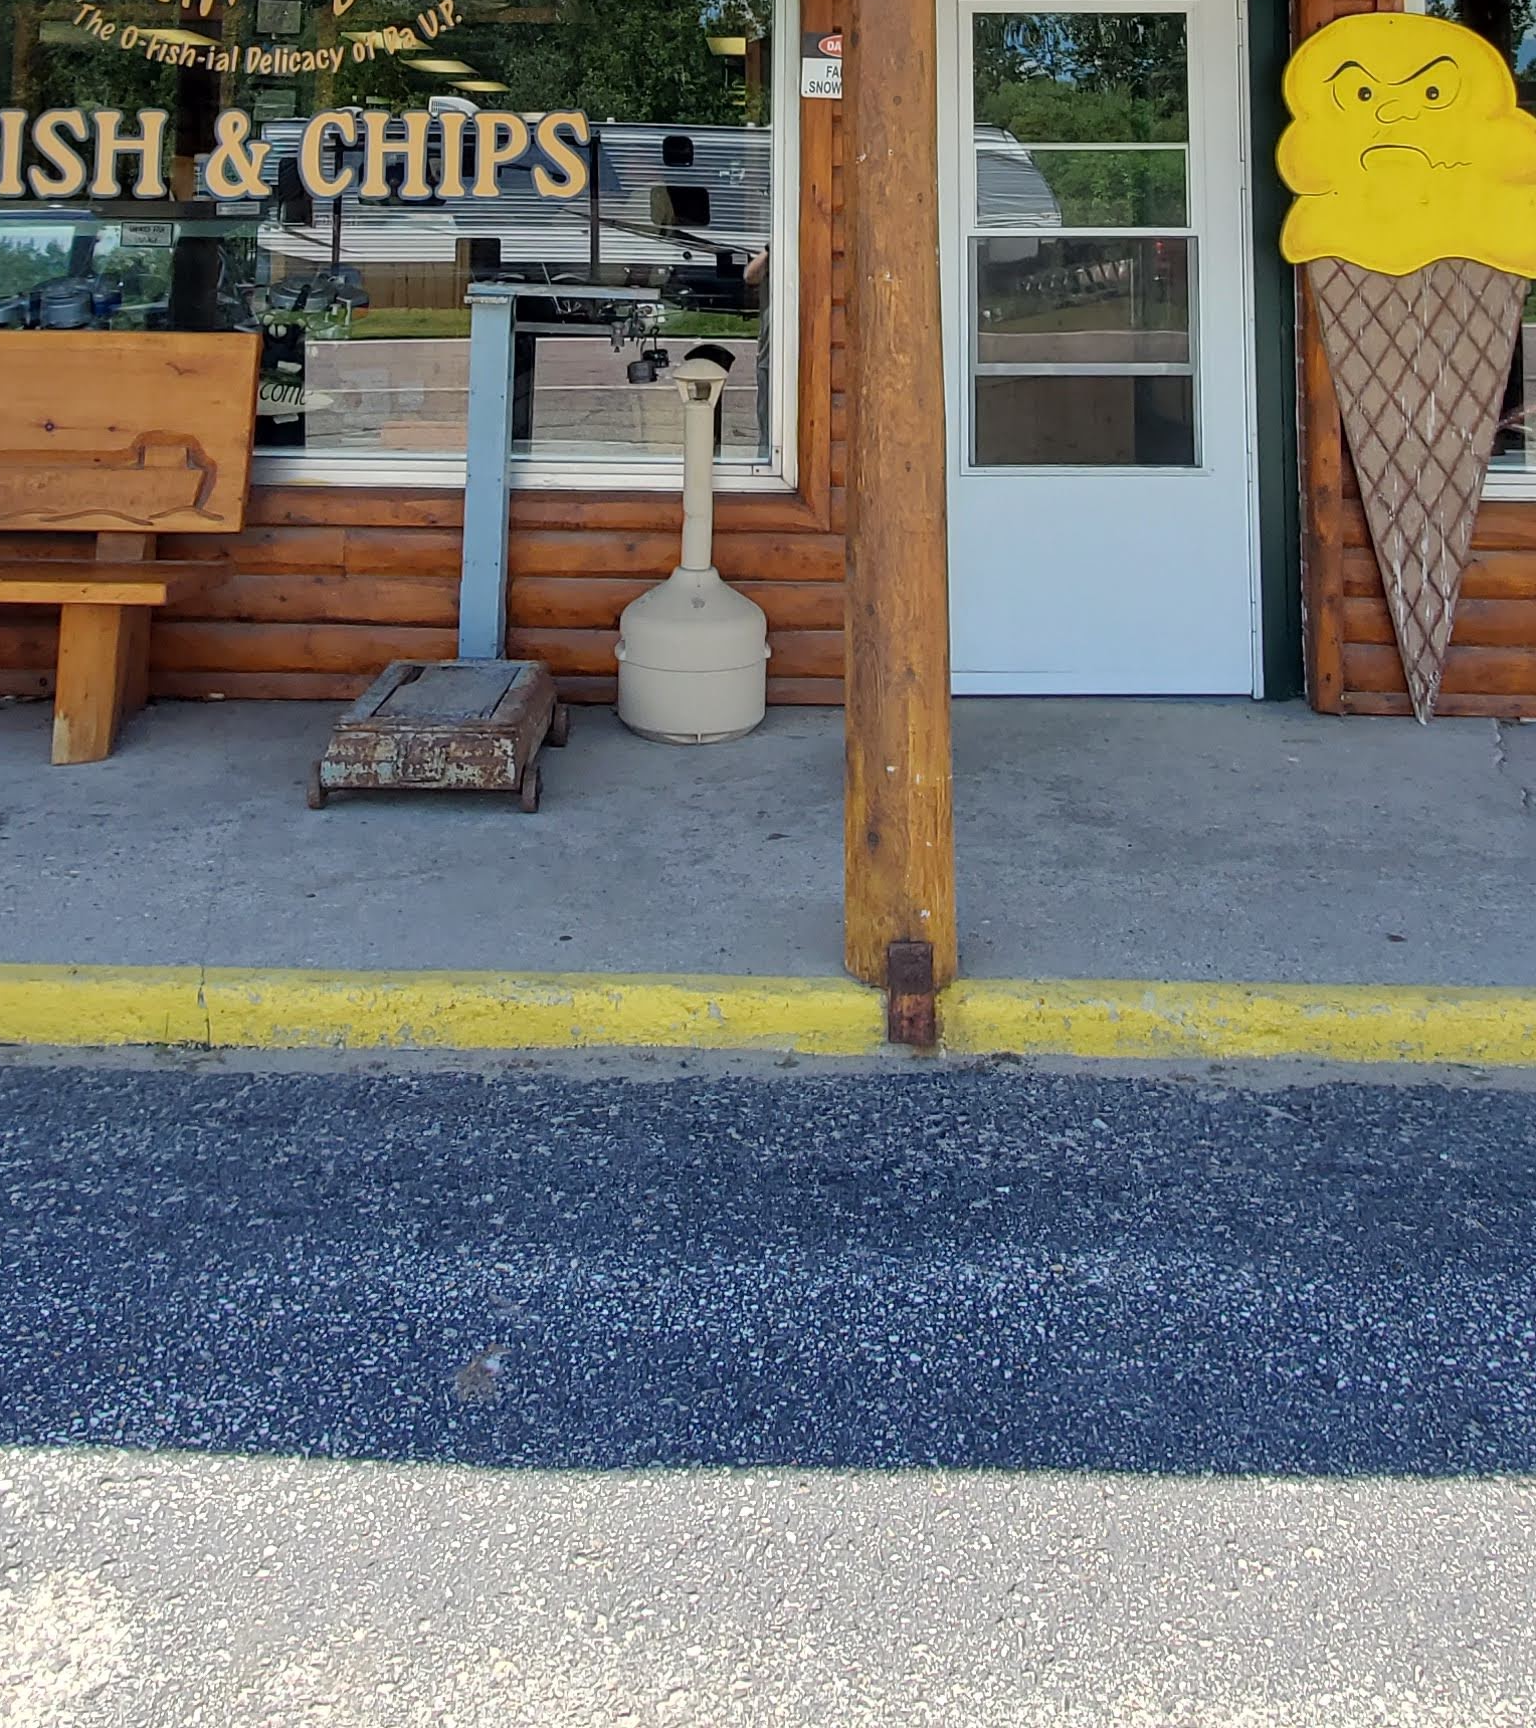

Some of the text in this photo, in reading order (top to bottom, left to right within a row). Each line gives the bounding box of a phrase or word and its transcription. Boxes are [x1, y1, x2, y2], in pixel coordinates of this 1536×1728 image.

[245, 45, 344, 74] Delicacy
[353, 30, 376, 63] of
[383, 25, 417, 55] Da
[827, 40, 842, 51] DA
[826, 65, 840, 78] FA
[202, 108, 273, 201] &
[298, 108, 591, 202] CHIPS
